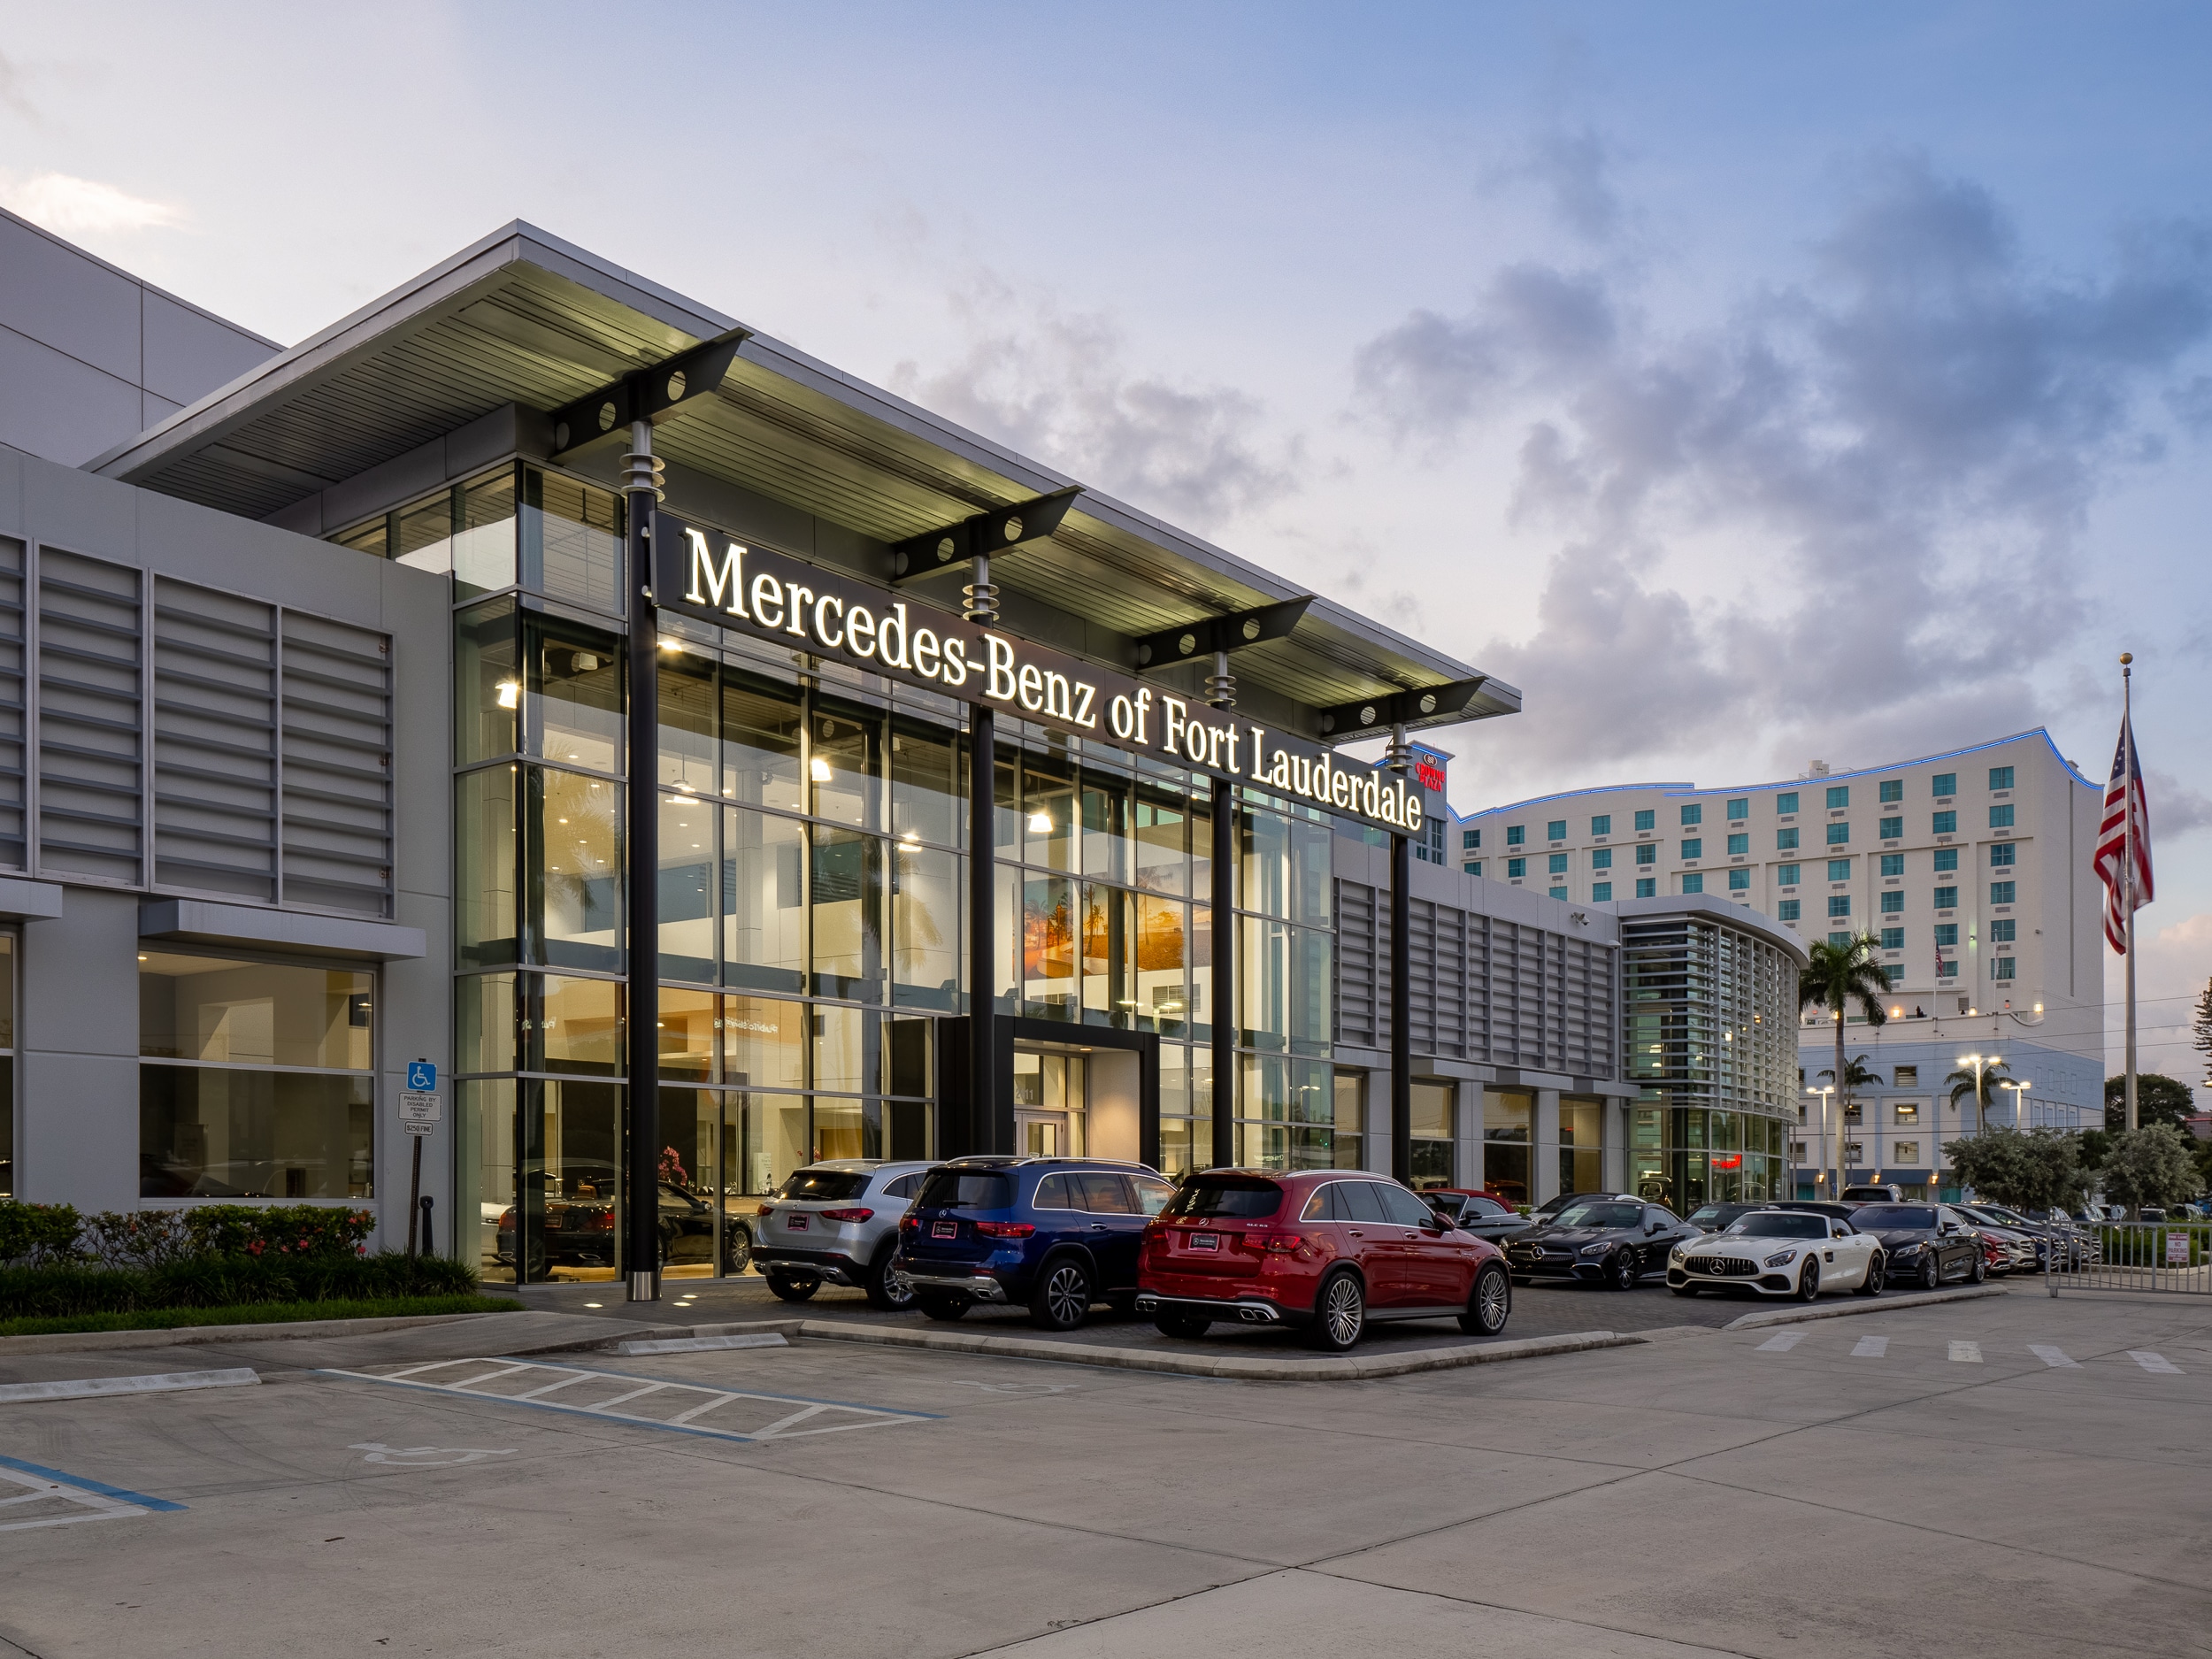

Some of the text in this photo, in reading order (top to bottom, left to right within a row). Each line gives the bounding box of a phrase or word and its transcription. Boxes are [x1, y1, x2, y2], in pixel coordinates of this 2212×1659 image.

[684, 527, 1422, 831] Mercedes-Benz of Fort Lauderdale
[1415, 762, 1446, 783] CROWNE
[1419, 774, 1442, 793] PLAZA
